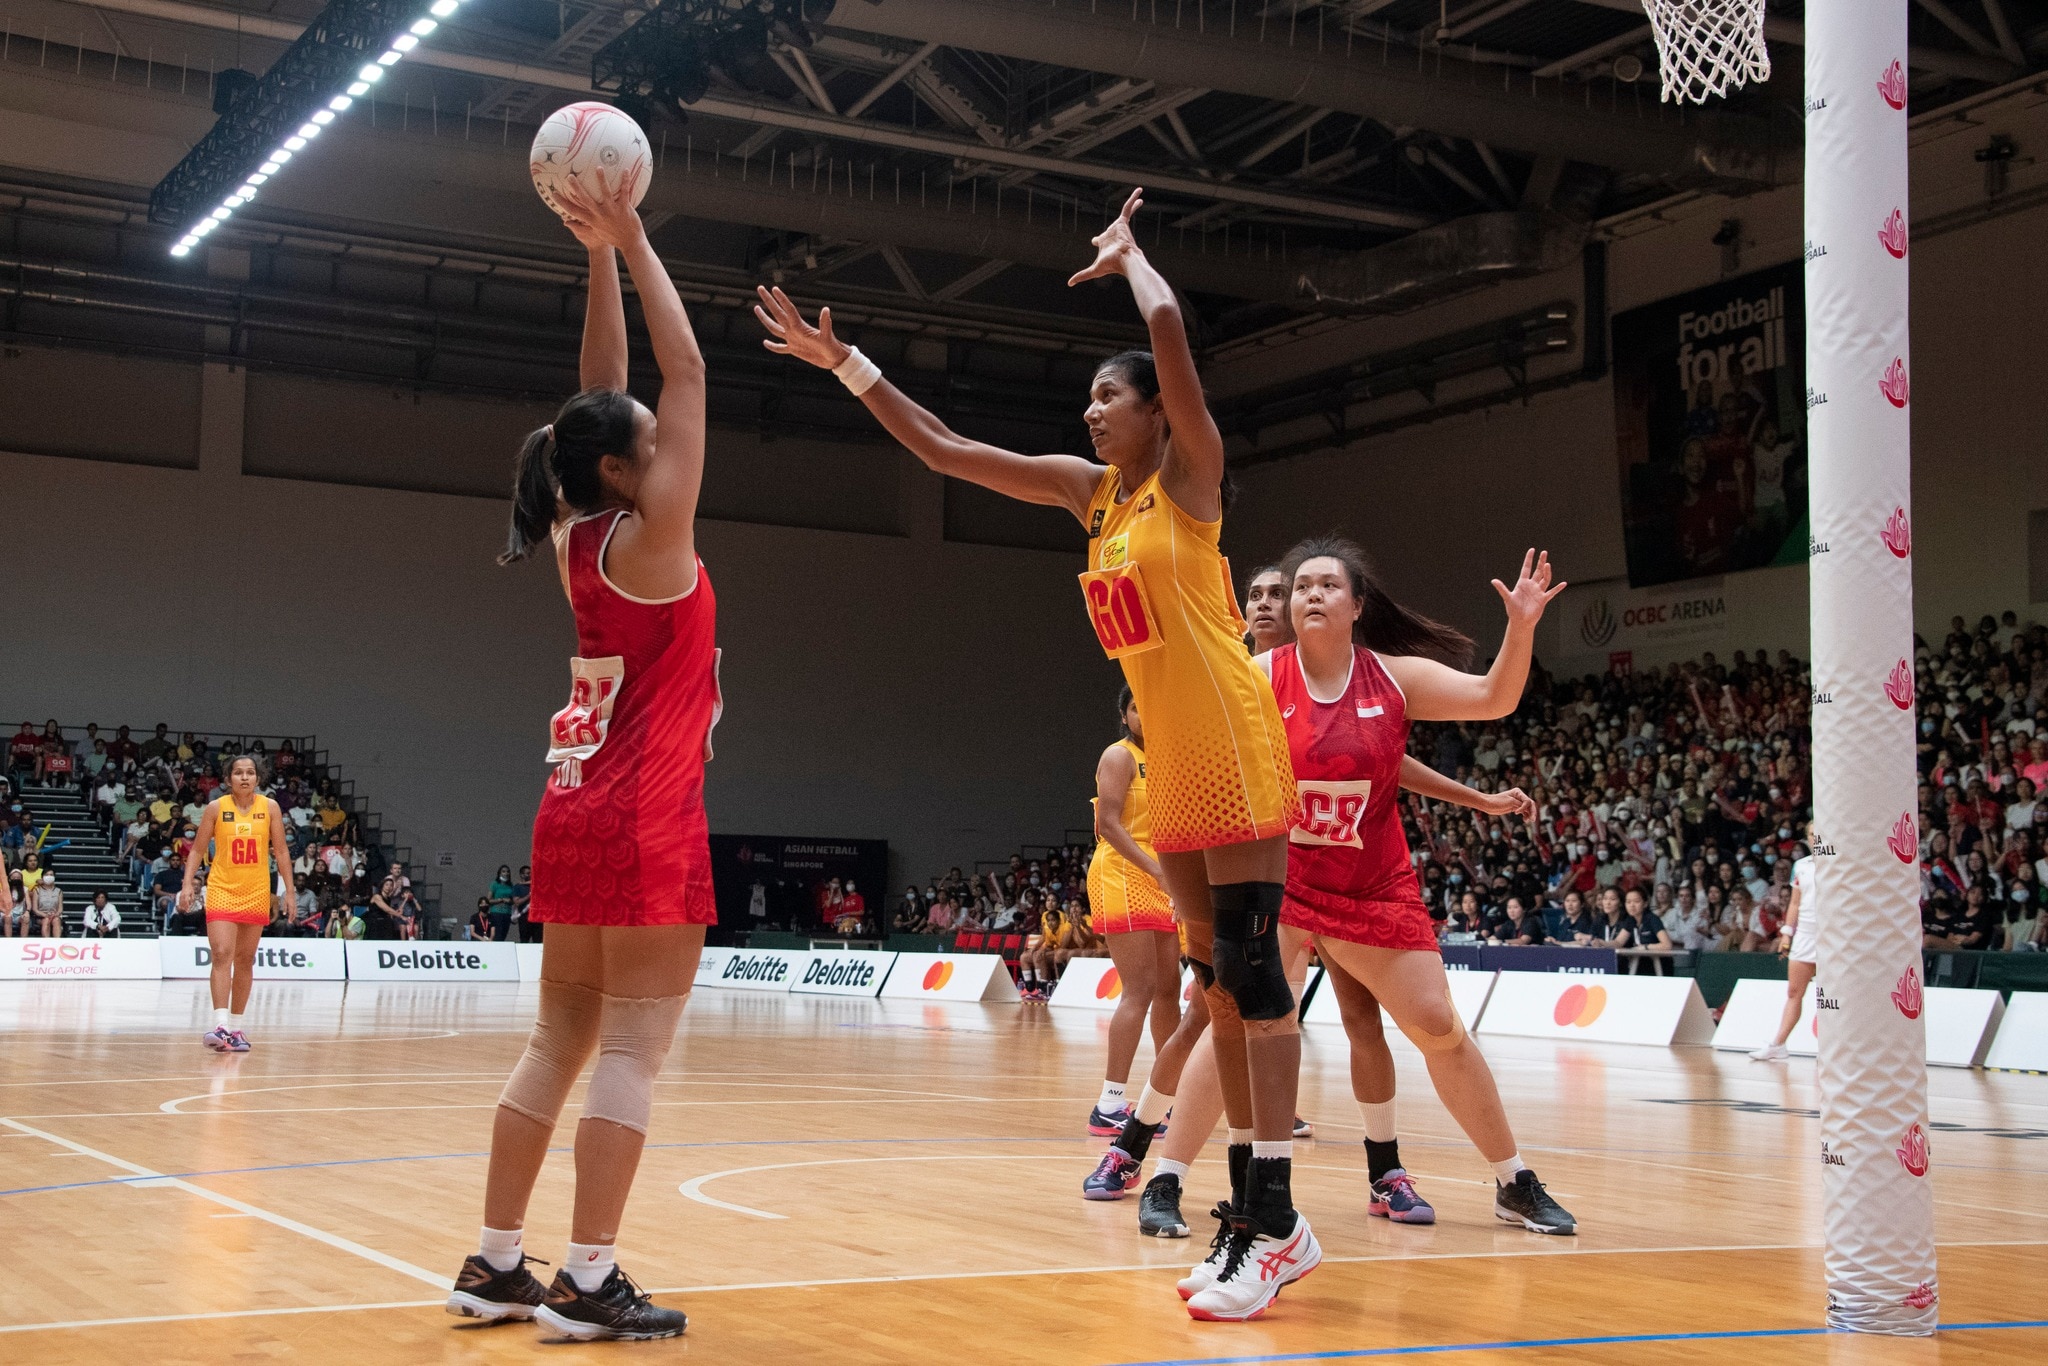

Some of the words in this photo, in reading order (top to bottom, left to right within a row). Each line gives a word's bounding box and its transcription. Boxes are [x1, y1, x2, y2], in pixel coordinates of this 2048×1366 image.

[1679, 286, 1784, 343] Football
[1677, 342, 1735, 391] for
[1739, 319, 1785, 375] all
[1088, 576, 1150, 650] GD
[1623, 605, 1668, 628] OCBC
[1671, 598, 1727, 620] ARENA
[231, 838, 259, 865] GA
[784, 844, 814, 853] ASIAN
[816, 846, 859, 855] NETBALL
[783, 861, 824, 869] SINGAPORE
[21, 944, 102, 965] Sport
[195, 946, 314, 968] Ditte.
[378, 950, 488, 970] Deloitte.
[27, 966, 98, 975] SINGAPORE
